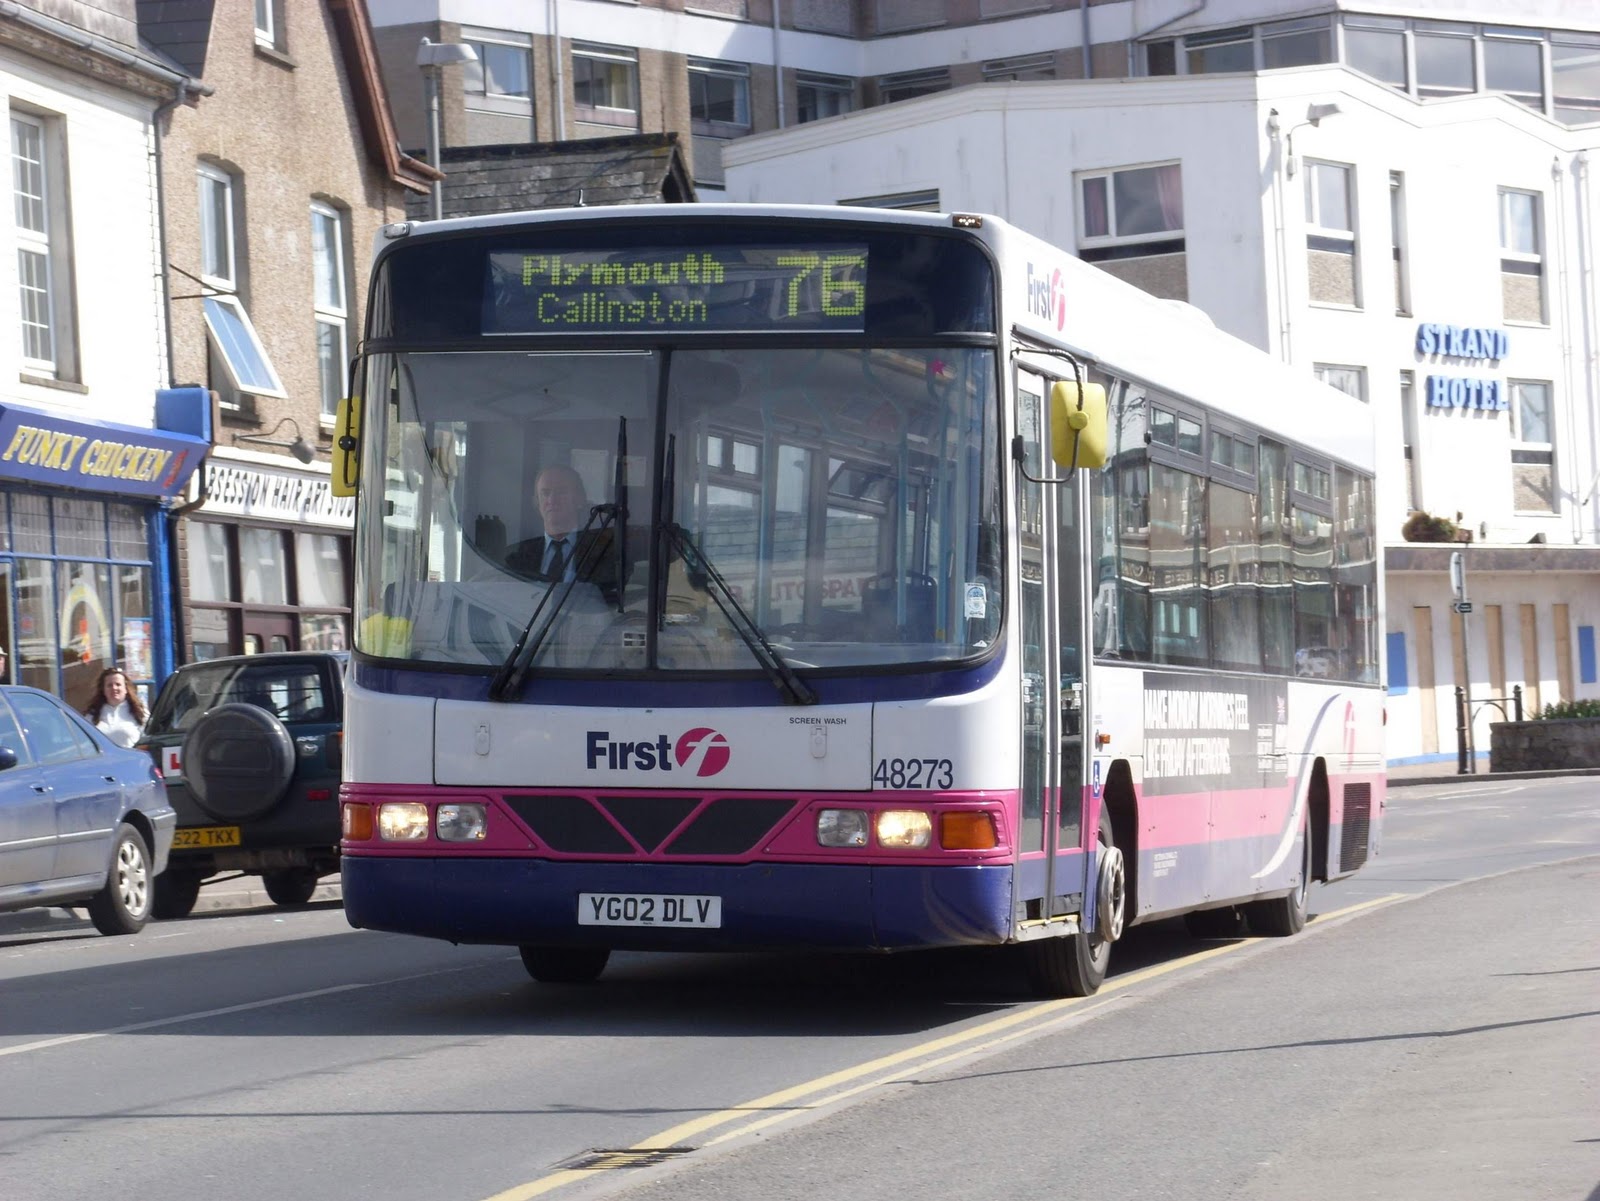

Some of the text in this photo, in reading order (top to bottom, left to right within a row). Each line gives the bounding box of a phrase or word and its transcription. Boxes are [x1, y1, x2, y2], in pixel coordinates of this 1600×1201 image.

[522, 253, 865, 317] Plymouth 76
[1026, 261, 1051, 321] First
[538, 292, 707, 323] Callington
[1415, 323, 1509, 361] STRAND
[1426, 375, 1509, 411] HOTEL
[2, 424, 173, 482] FUNKY CHICKEN
[206, 466, 270, 508] BSESSION
[271, 475, 303, 512] HAIR
[303, 480, 328, 515] ART
[789, 717, 847, 725] SCREEN WASH
[586, 731, 673, 771] First
[873, 758, 954, 790] 48273
[174, 829, 235, 846] 522 TKX
[590, 897, 711, 923] YG02 DLV
